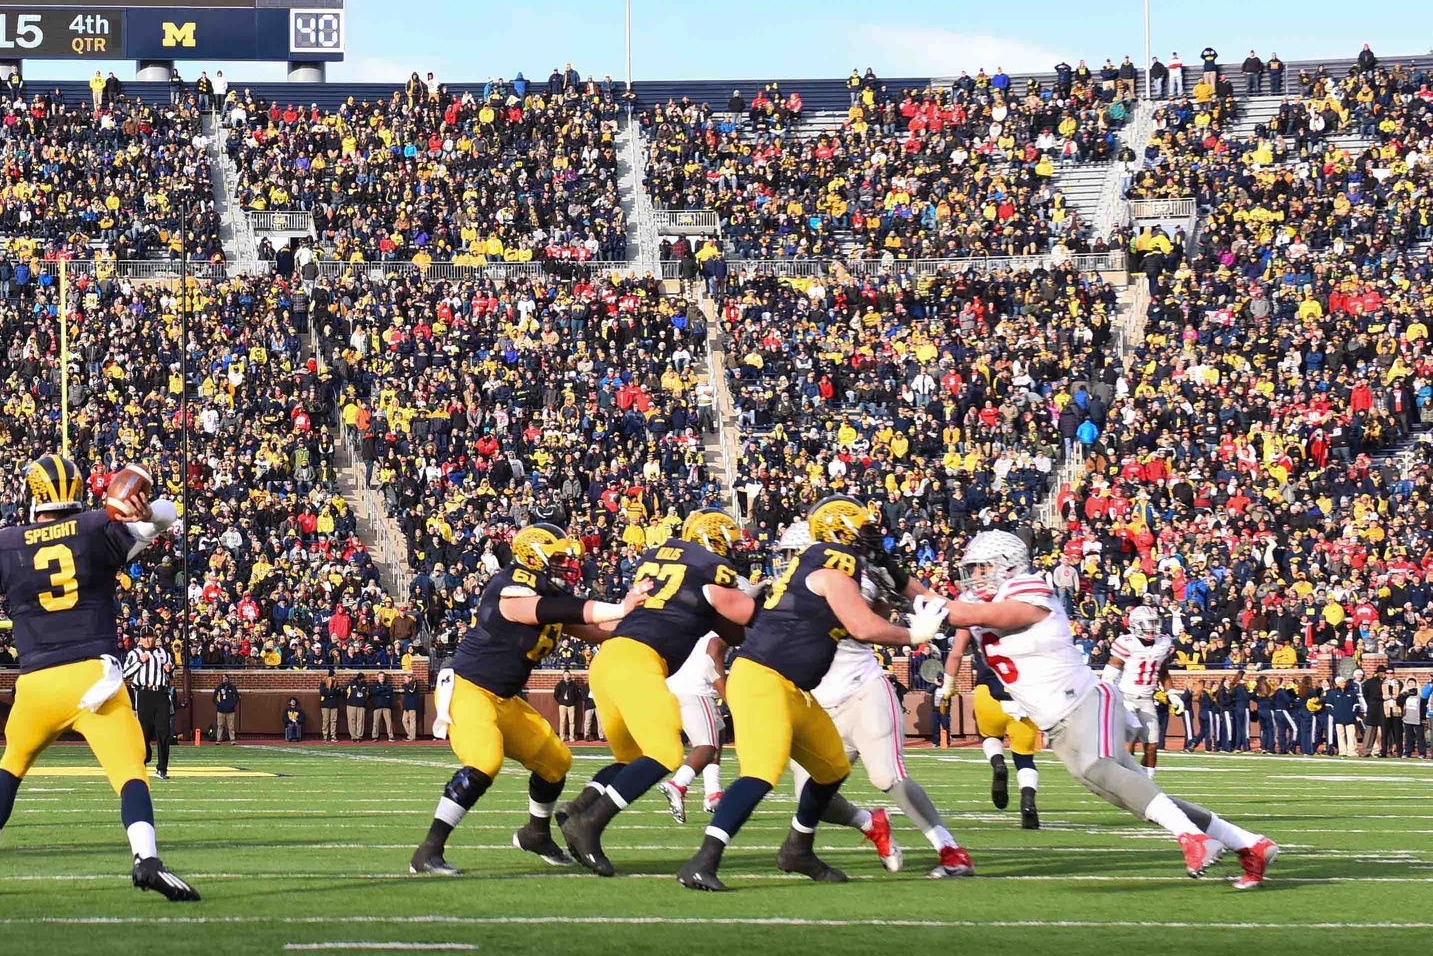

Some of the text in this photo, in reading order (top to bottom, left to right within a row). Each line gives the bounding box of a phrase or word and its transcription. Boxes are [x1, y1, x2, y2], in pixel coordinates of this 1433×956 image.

[69, 15, 110, 35] 4th
[162, 22, 196, 47] M
[296, 14, 338, 47] 40
[71, 37, 106, 54] QTR
[24, 520, 78, 545] SPEIGHT
[823, 548, 857, 577] 78
[33, 544, 79, 612] 3
[512, 568, 537, 588] 61
[1134, 661, 1158, 686] 11
